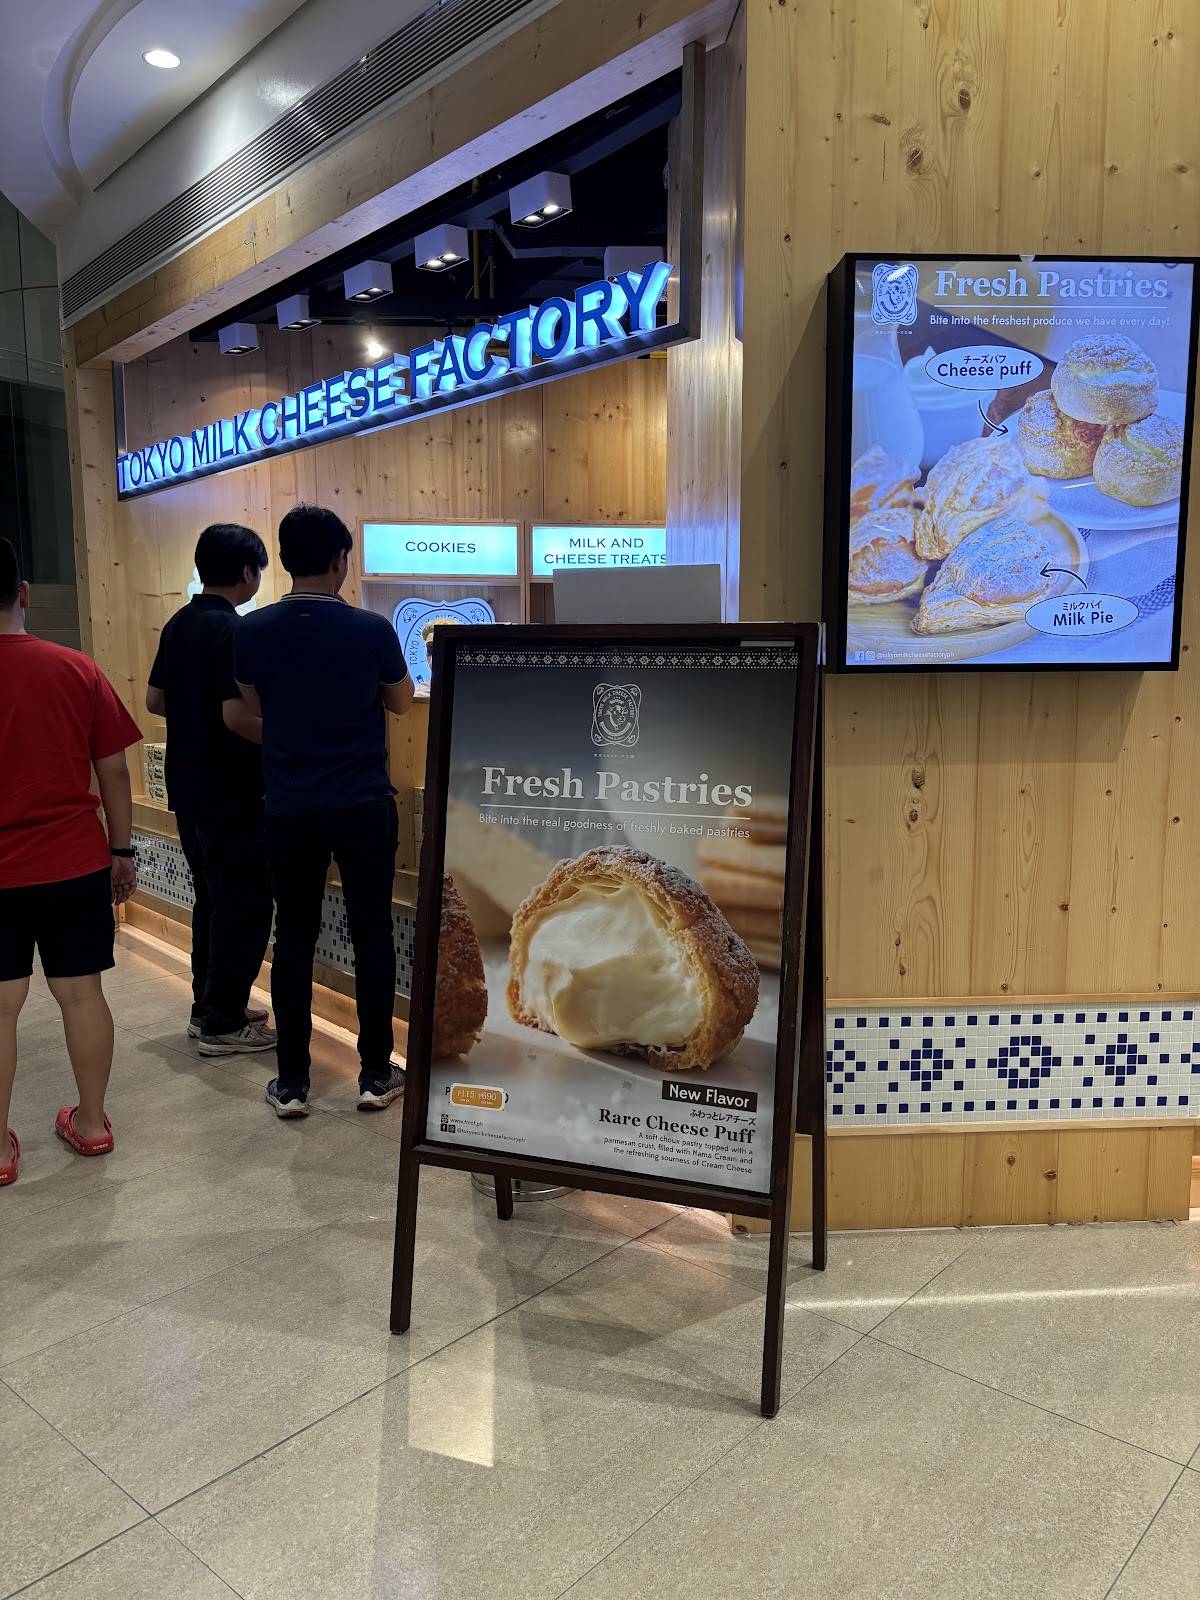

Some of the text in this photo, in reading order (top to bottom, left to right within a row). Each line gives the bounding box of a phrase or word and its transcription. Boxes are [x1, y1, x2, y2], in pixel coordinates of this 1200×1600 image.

[935, 268, 1029, 298] Fresh
[1037, 270, 1169, 298] Pastries
[930, 315, 1170, 329] Bite into the freshest produce we have every day!
[117, 261, 671, 490] TOKYO MILK CHEESE FACTORY
[937, 361, 1032, 380] Cheese puff
[405, 541, 477, 554] COOKIES
[569, 538, 644, 549] MILK AND
[543, 553, 667, 565] CHEESE TREATS
[1053, 611, 1114, 627] Milk Pie
[409, 640, 420, 667] TOKYO
[481, 766, 753, 808] Fresh Pastries
[480, 813, 751, 839] Bite into the real goodness of freshly baked pastries
[669, 1083, 750, 1108] New Flavor
[599, 1108, 756, 1144] Rare Cheese Puff
[690, 1109, 757, 1126] ふわっとレアチーズ
[603, 1137, 753, 1165] parmesan crust, filled with Nama Cream and
[645, 1133, 659, 1141] soft
[660, 1135, 681, 1144] choux
[682, 1140, 703, 1150] pastry
[704, 1143, 729, 1153] topped
[731, 1146, 747, 1155] with
[626, 1149, 660, 1162] refreshing
[661, 1155, 691, 1165] sourness
[701, 1160, 725, 1169] Cream
[726, 1164, 753, 1174] Cheese
